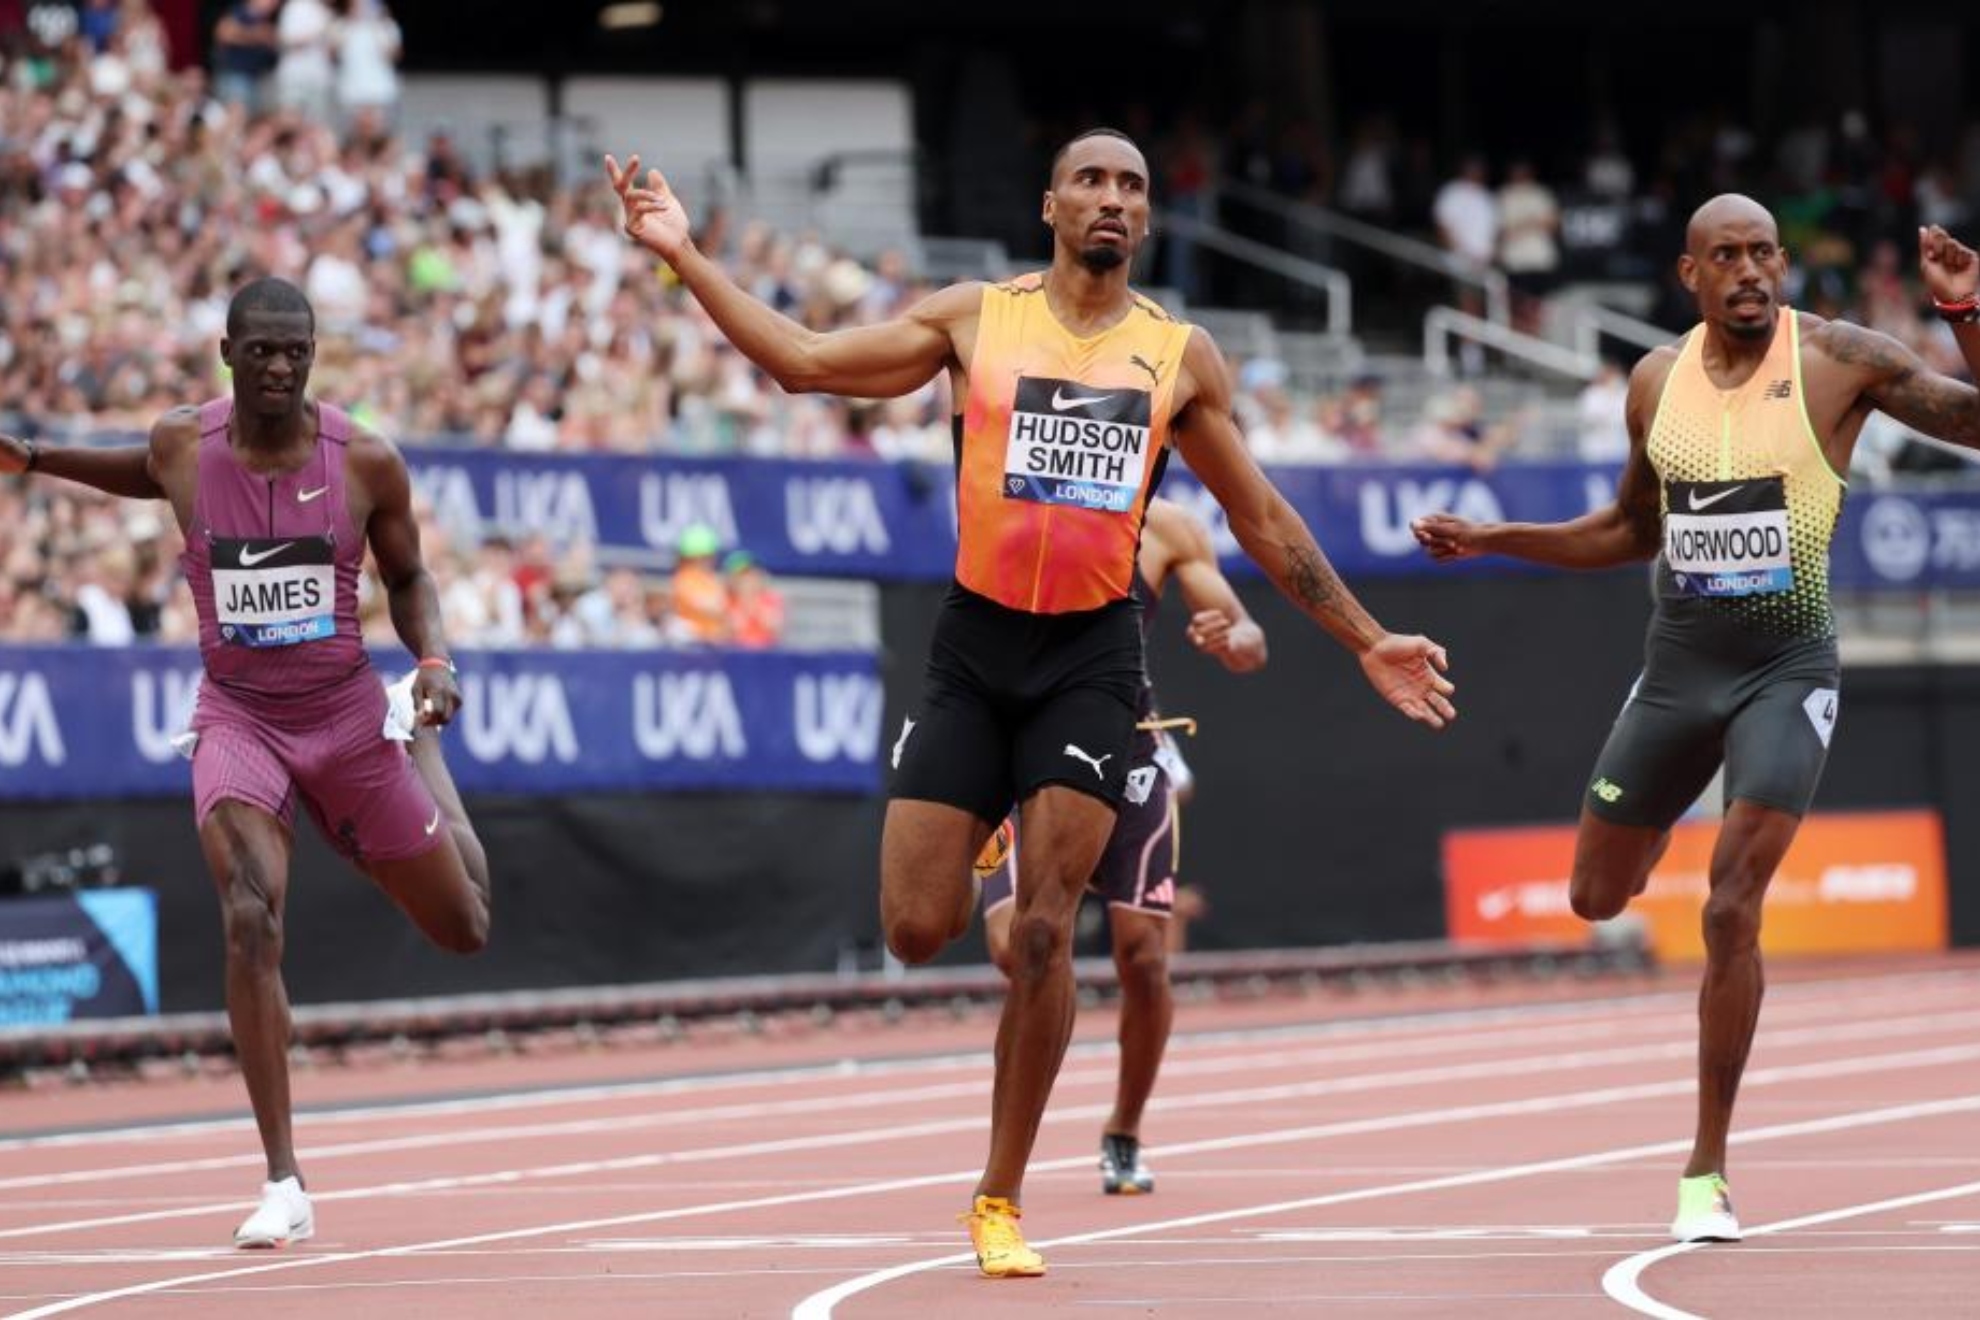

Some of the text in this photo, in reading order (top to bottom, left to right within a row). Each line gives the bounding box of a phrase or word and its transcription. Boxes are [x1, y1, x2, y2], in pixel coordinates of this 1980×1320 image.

[1015, 414, 1142, 454] HUDSON
[1026, 446, 1125, 482] SMITH
[1055, 484, 1127, 506] LONDON
[1670, 526, 1782, 561] NORWOOD
[226, 577, 321, 614] JAMES
[1707, 573, 1773, 592] LONDON
[257, 621, 319, 641] LONDON
